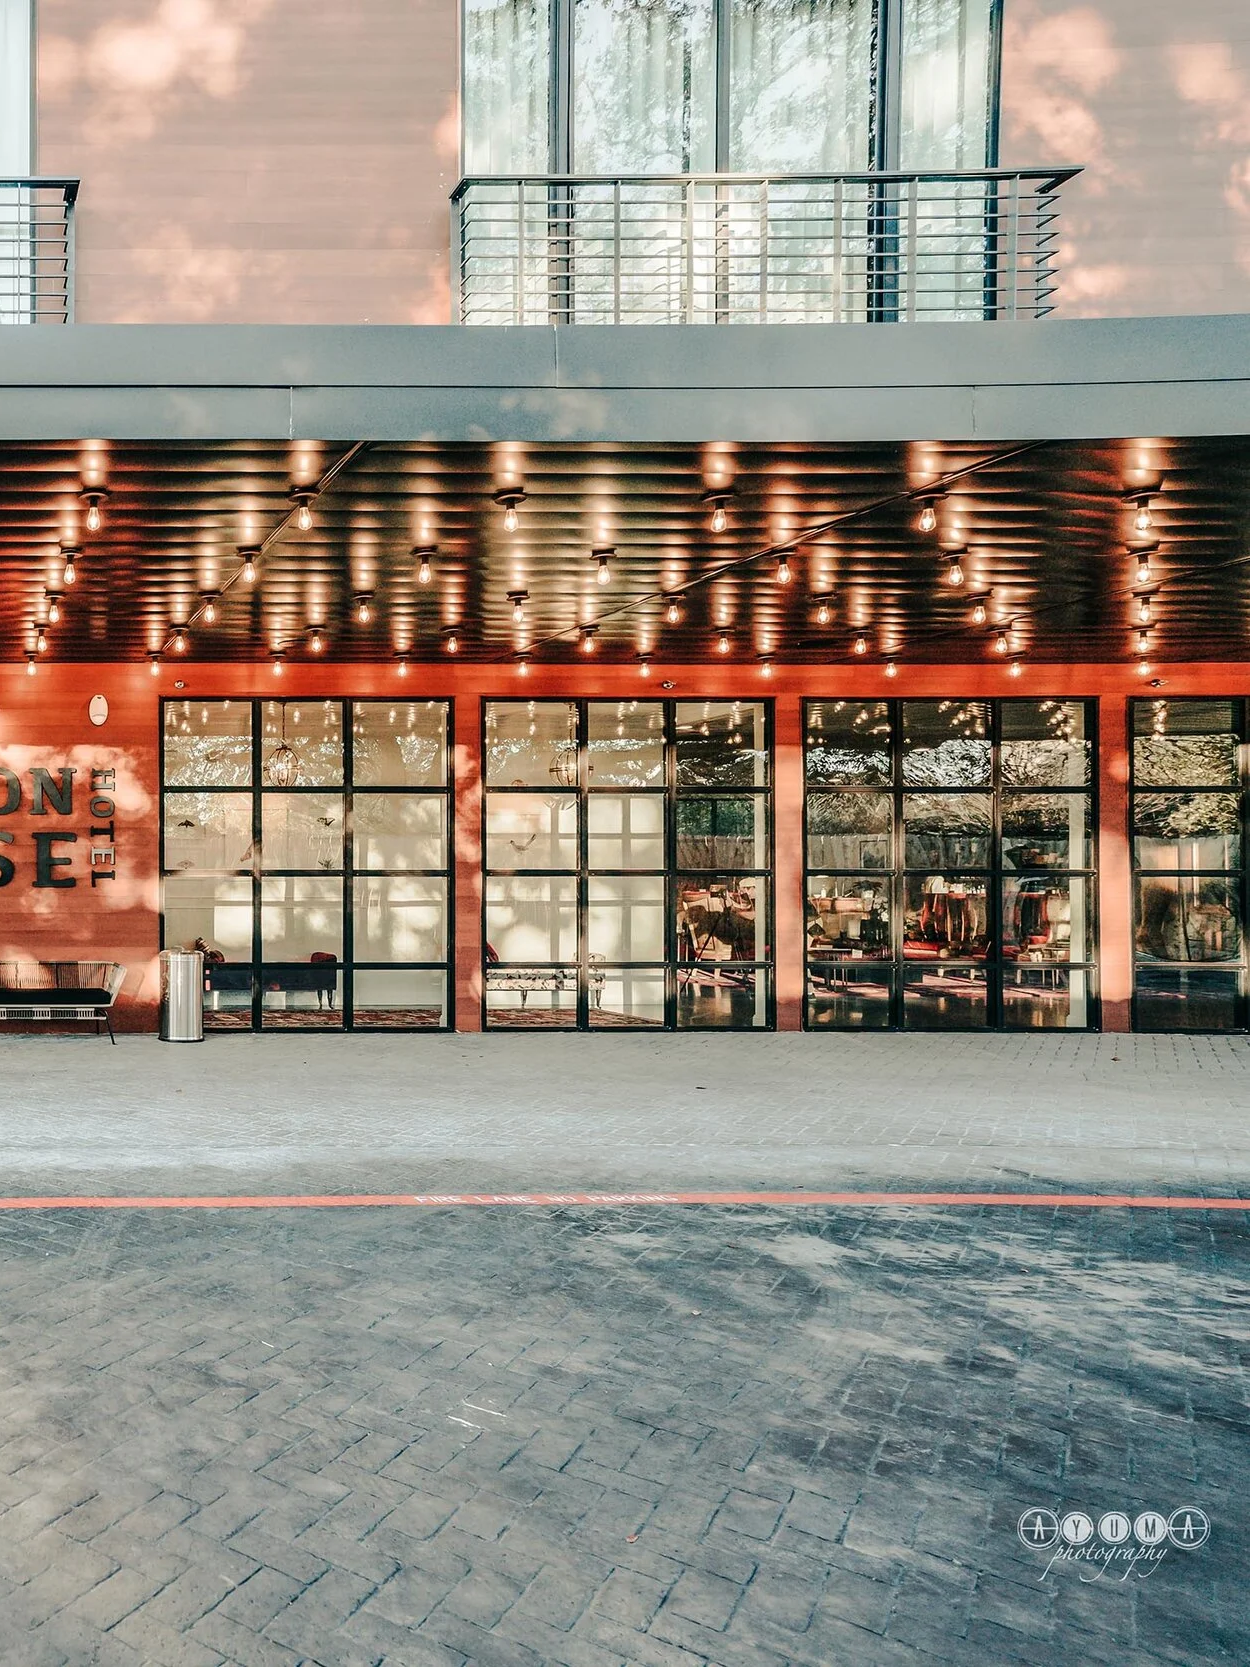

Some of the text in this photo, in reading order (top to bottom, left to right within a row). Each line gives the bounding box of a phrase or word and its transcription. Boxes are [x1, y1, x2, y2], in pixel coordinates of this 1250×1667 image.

[90, 768, 116, 888] HOTEL
[413, 1194, 679, 1204] FIRE LANE NO PARKING
